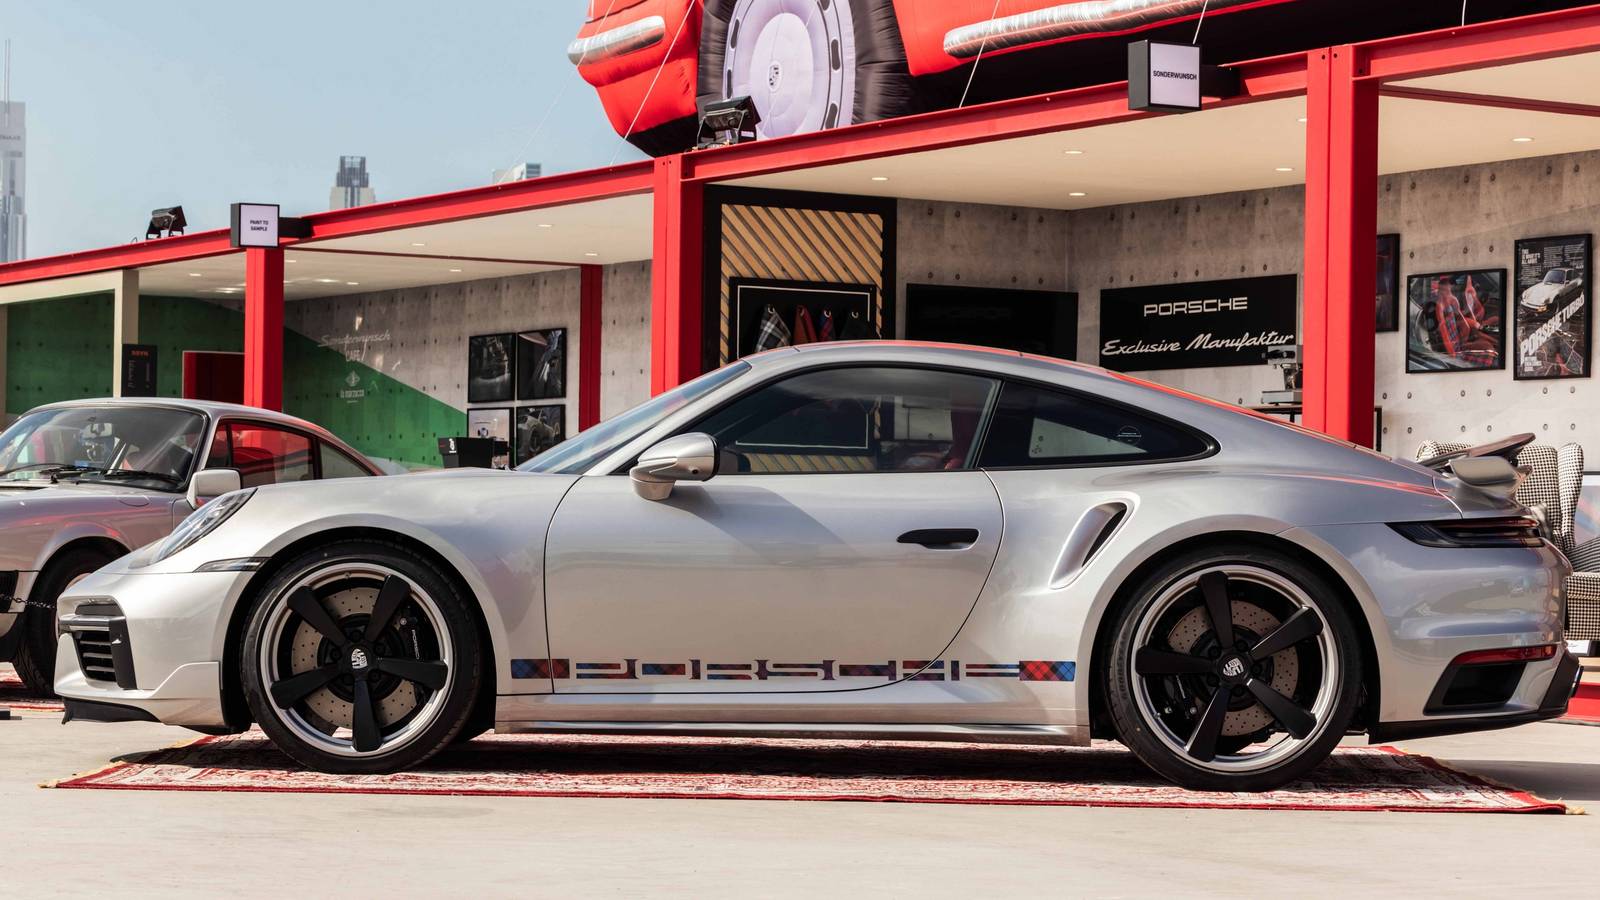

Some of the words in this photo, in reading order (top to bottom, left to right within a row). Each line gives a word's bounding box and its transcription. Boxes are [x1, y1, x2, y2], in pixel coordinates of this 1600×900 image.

[1153, 70, 1197, 80] SONDERWUNSCH
[1143, 296, 1248, 317] PORSCHE
[1521, 311, 1562, 366] PORSCHE
[1562, 291, 1584, 323] TURBO
[1101, 338, 1181, 356] Exclusive
[1185, 331, 1294, 351] Manufaktur
[568, 658, 1020, 681] PORSCHE
